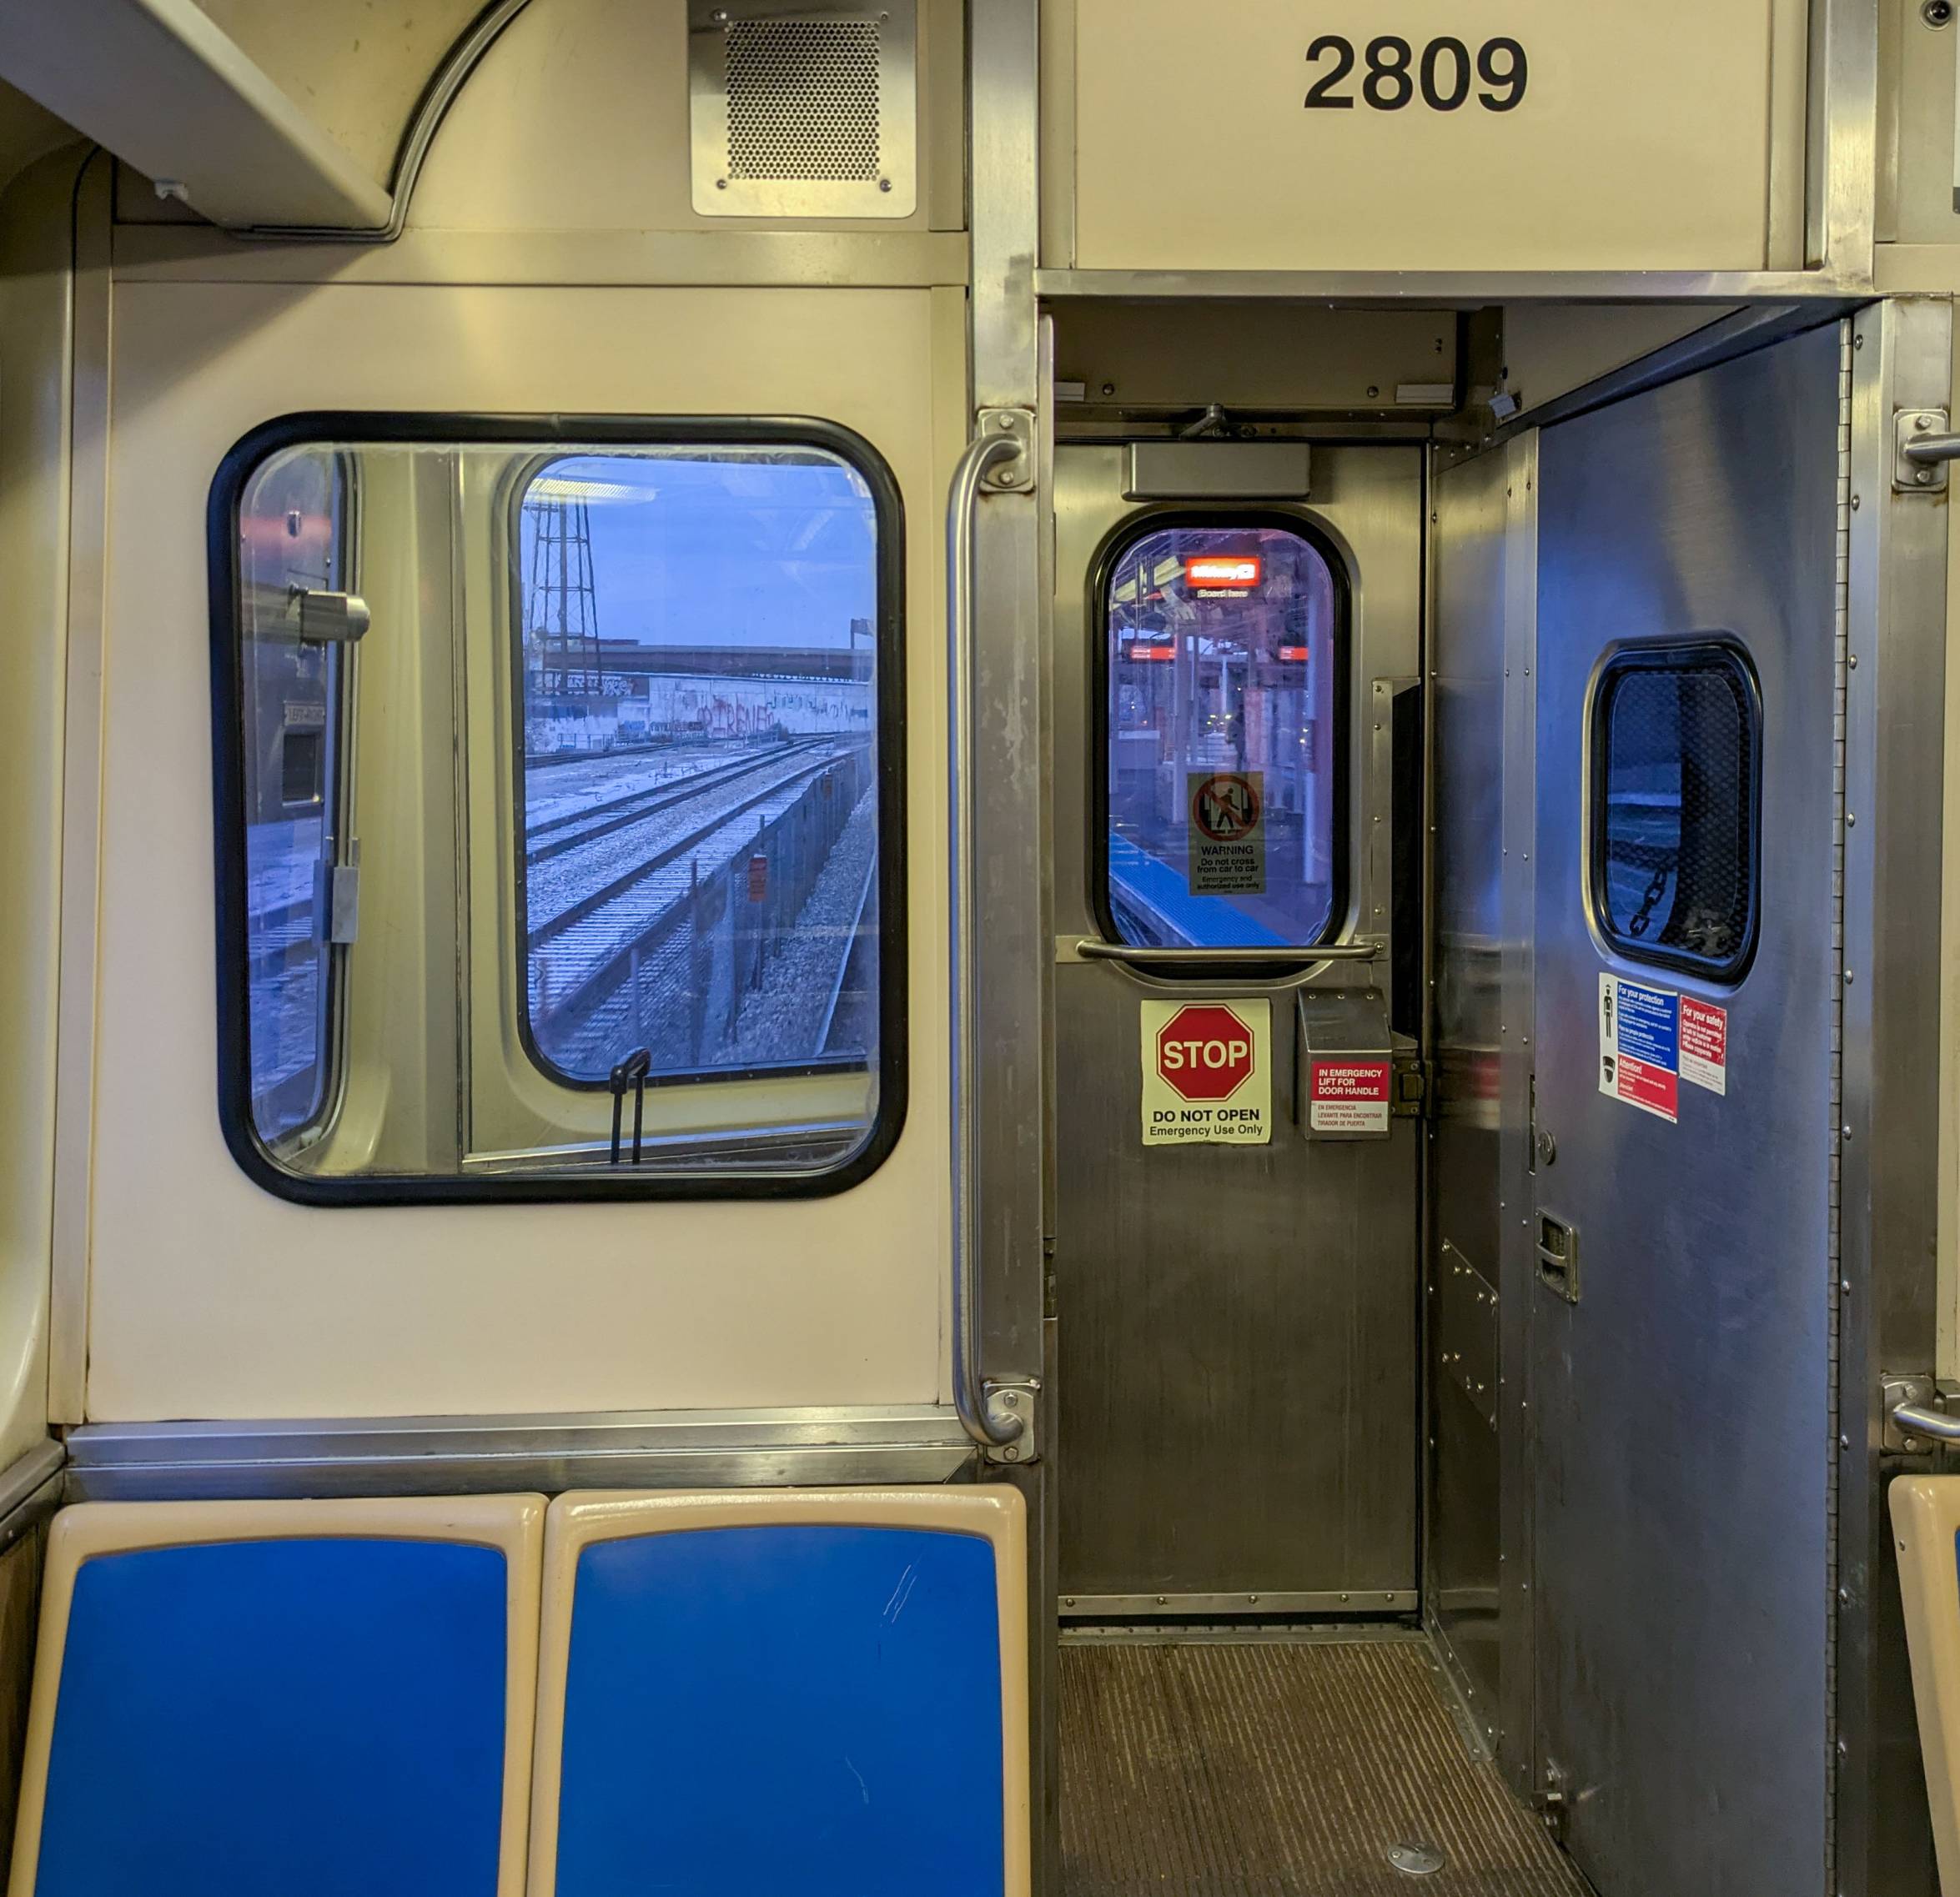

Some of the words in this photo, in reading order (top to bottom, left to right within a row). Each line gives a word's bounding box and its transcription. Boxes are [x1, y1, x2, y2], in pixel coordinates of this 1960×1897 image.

[1304, 34, 1528, 113] 2809
[1197, 590, 1226, 598] Board
[1228, 590, 1249, 598] here
[1201, 846, 1254, 856] WARNING
[1627, 988, 1638, 998] your
[1639, 992, 1664, 1006] protection
[1683, 1005, 1692, 1016] For
[1693, 1011, 1706, 1021] your
[1706, 1015, 1723, 1031] safety
[1163, 1040, 1248, 1069] STOP
[1319, 1069, 1328, 1077] IN
[1329, 1069, 1383, 1078] EMERGENCY
[1319, 1077, 1335, 1087] LIFT
[1337, 1077, 1355, 1087] FOR
[1319, 1087, 1344, 1096] DOOR
[1345, 1087, 1380, 1096] HANDLE
[1153, 1109, 1177, 1122] DO
[1180, 1109, 1213, 1122] NOT
[1216, 1108, 1260, 1122] OPEN
[1149, 1126, 1210, 1138] Emergency
[1214, 1124, 1234, 1135] Use
[1238, 1123, 1263, 1137] Only
